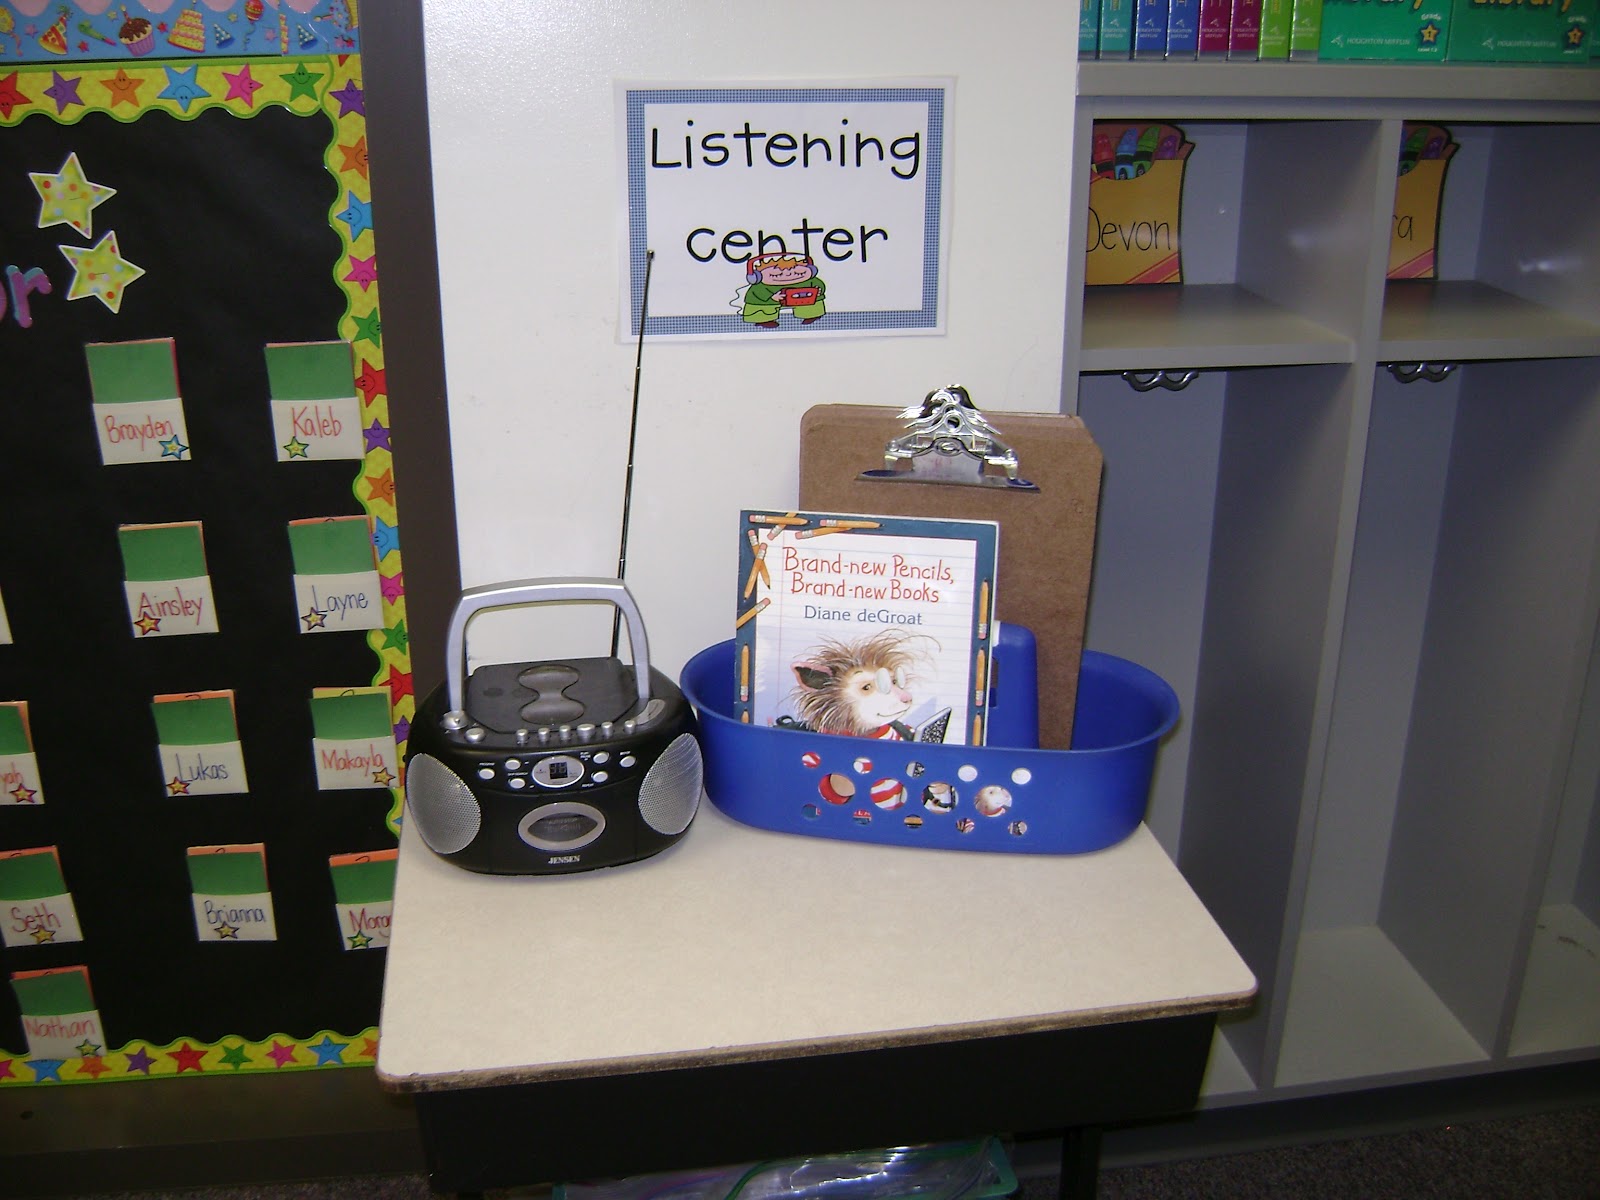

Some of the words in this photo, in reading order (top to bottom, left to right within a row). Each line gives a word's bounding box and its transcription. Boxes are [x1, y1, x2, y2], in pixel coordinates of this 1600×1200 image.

[651, 118, 921, 180] Listening
[686, 218, 889, 264] center
[1392, 214, 1413, 241] a
[104, 414, 174, 452] Brayden
[291, 406, 343, 438] Kaleb
[782, 546, 886, 576] Brand-new
[892, 554, 956, 585] Pencils,
[311, 584, 369, 621] Layne
[791, 572, 888, 600] Brand-new
[890, 579, 940, 603] Books
[138, 586, 205, 625] Ainsley
[804, 605, 851, 621] Diane
[857, 608, 923, 626] deGroat
[176, 753, 230, 784] Lukas
[321, 743, 385, 777] Makayla
[547, 854, 581, 865] JENSEN
[10, 905, 62, 933] Seth
[203, 900, 266, 926] Brianna
[25, 1017, 96, 1039] Nathan
